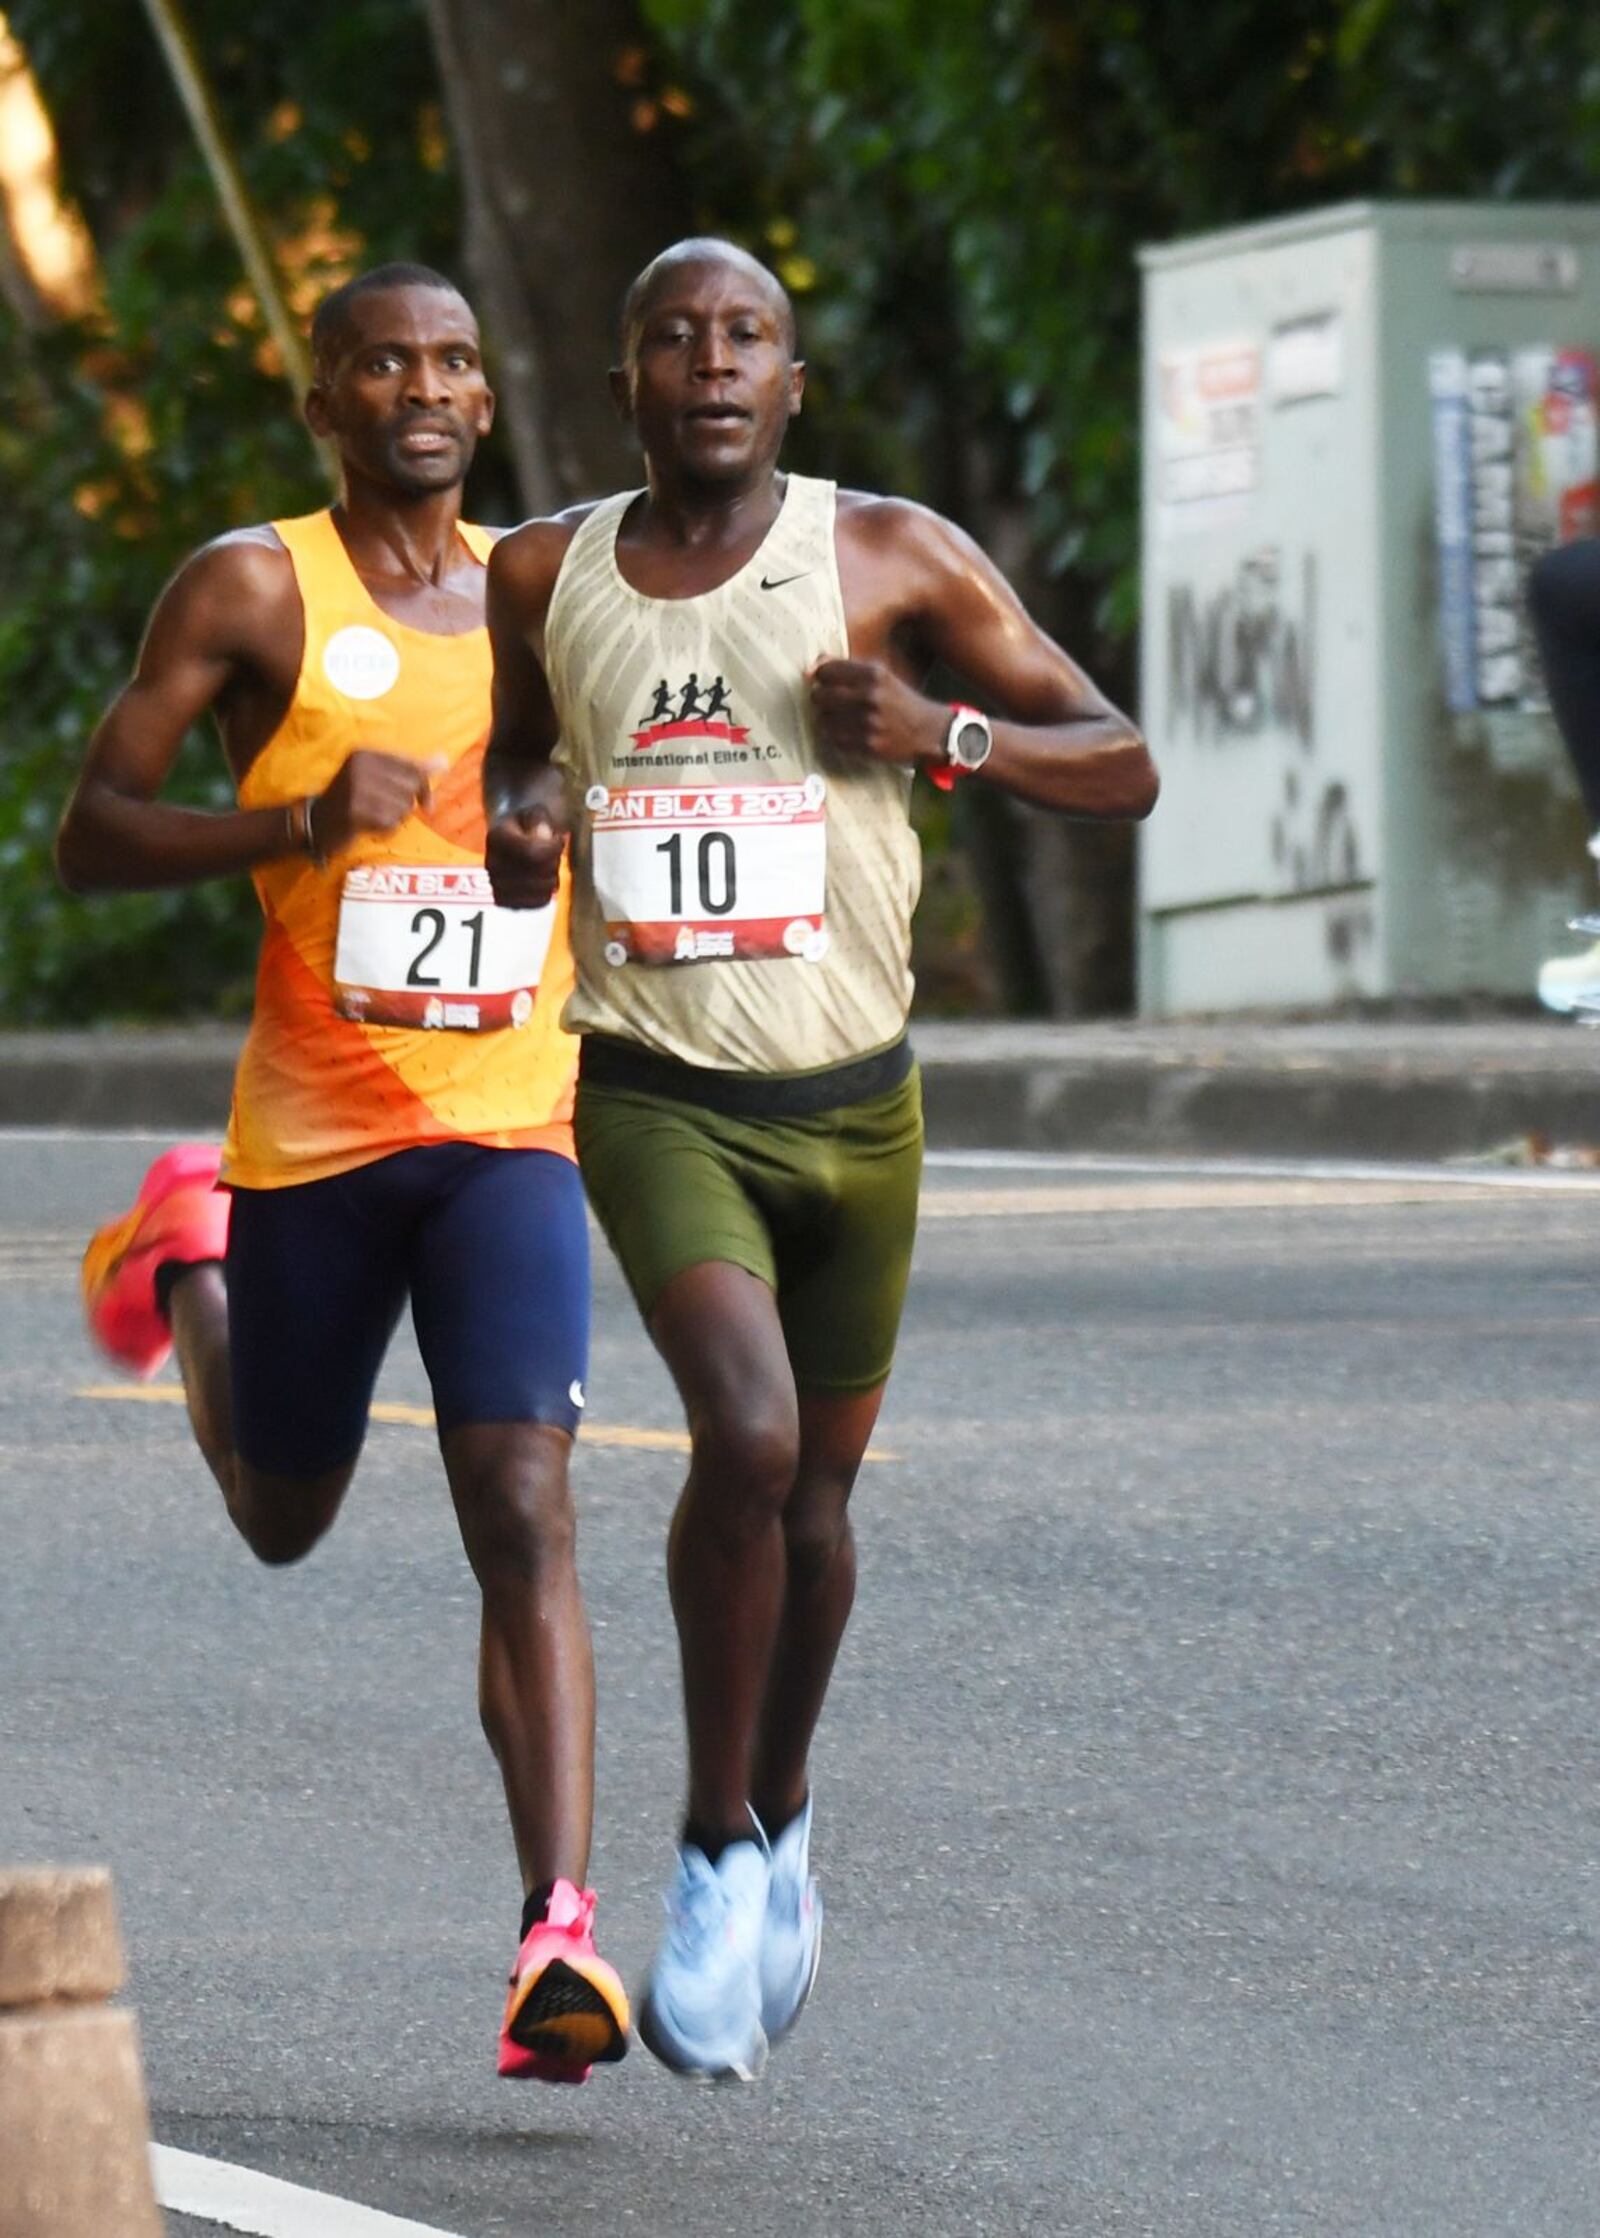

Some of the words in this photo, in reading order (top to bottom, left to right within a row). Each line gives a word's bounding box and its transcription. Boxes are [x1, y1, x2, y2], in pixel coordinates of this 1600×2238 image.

[652, 794, 735, 819] BLAS
[347, 869, 410, 895] SAN
[416, 873, 492, 897] BLAS
[656, 831, 737, 916] 10
[406, 908, 484, 988] 21
